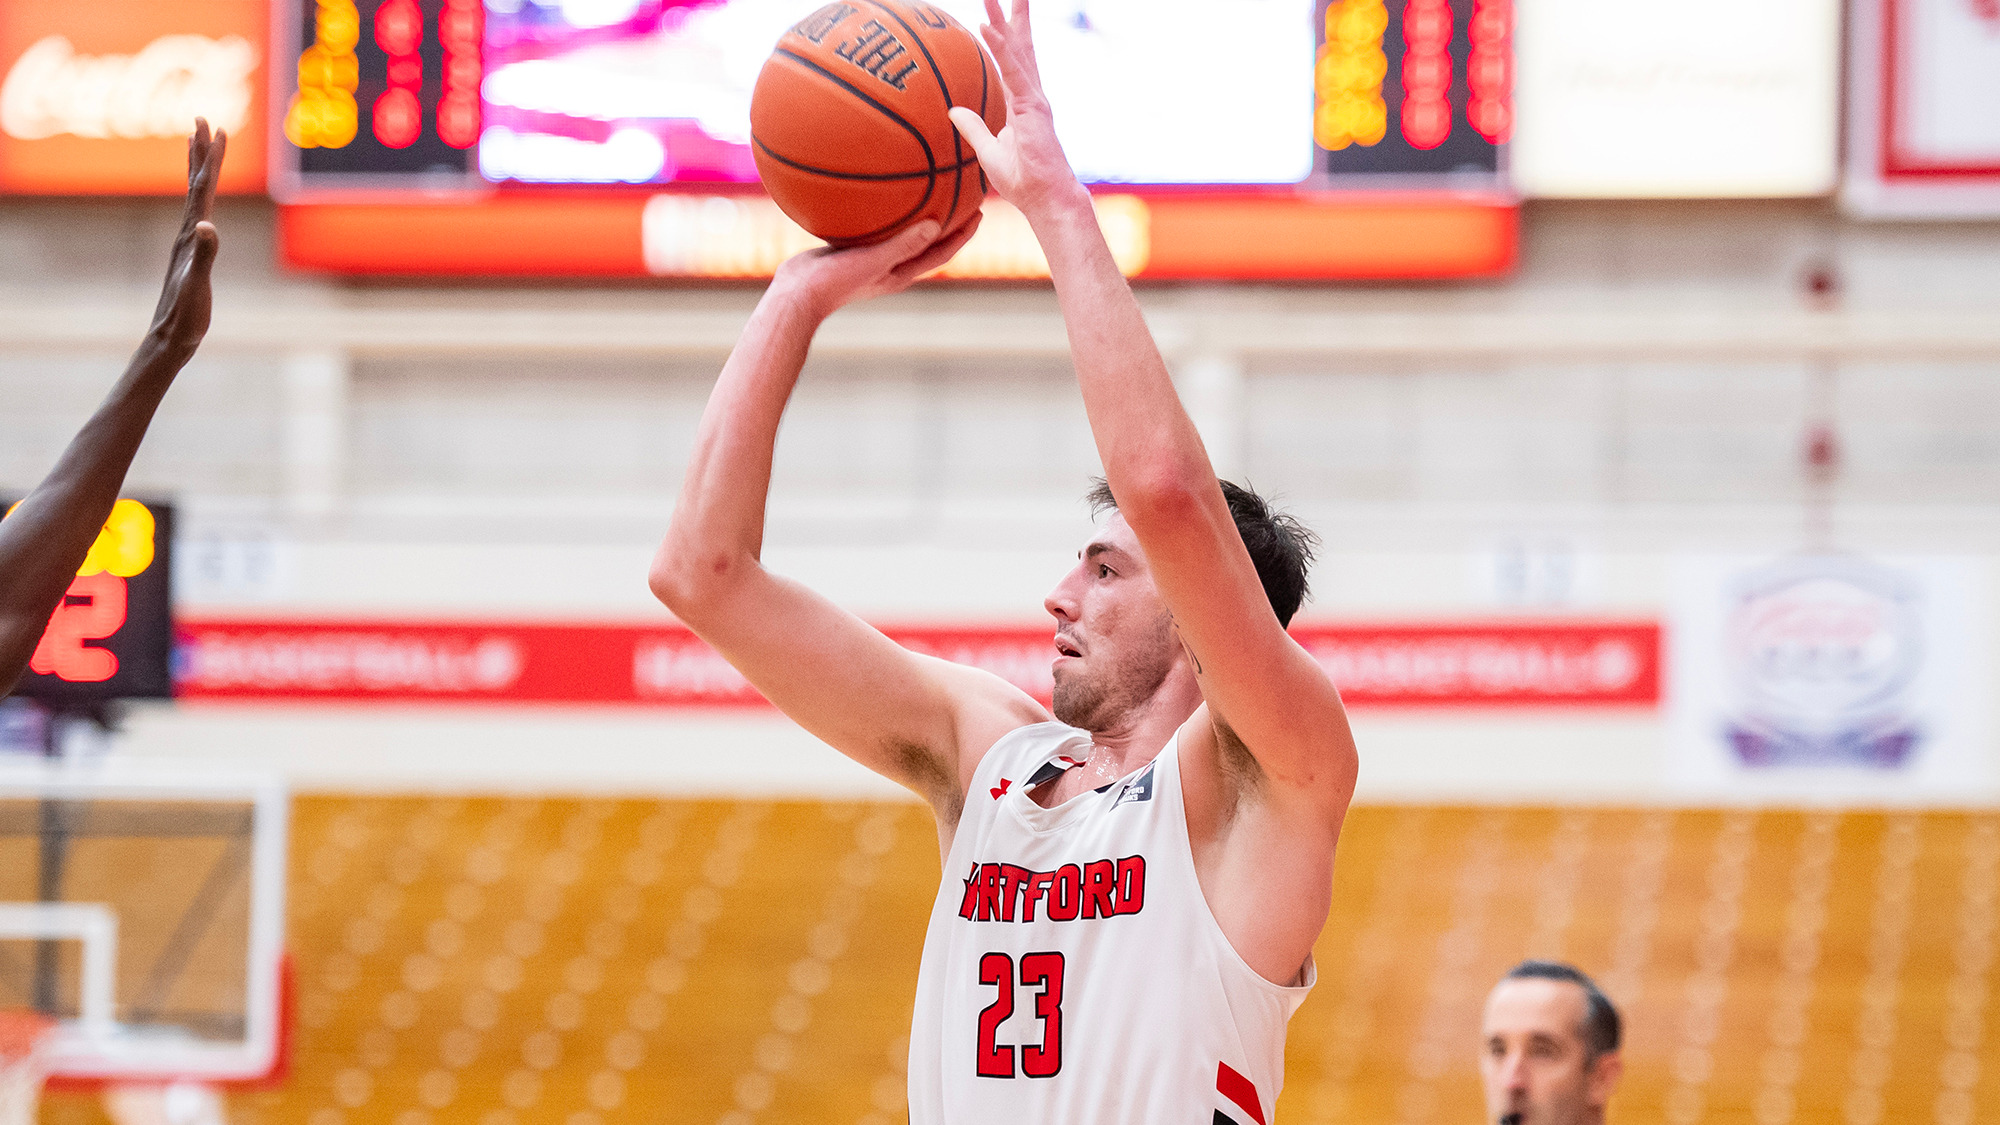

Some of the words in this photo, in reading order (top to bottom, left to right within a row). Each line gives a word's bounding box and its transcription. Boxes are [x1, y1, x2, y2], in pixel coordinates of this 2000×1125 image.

[835, 18, 920, 92] THE
[958, 855, 1147, 924] RTFORD
[975, 951, 1065, 1079] 23
